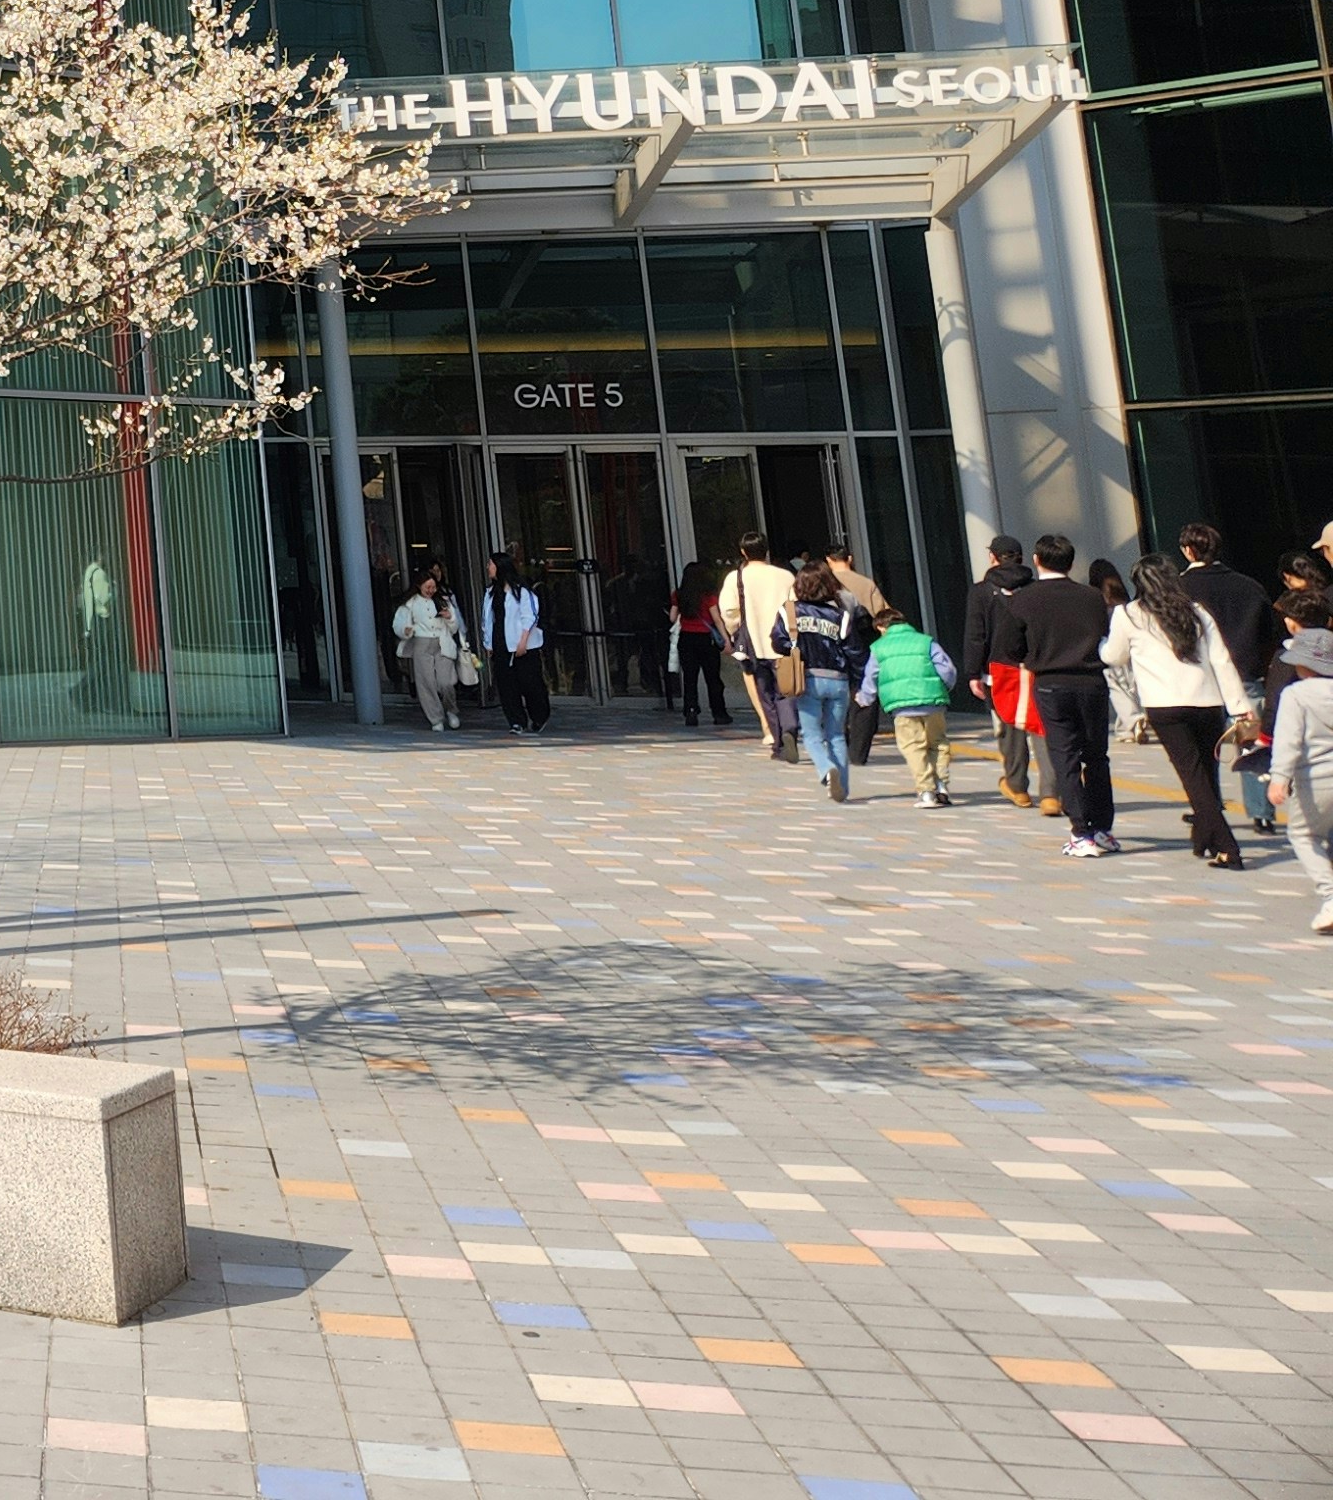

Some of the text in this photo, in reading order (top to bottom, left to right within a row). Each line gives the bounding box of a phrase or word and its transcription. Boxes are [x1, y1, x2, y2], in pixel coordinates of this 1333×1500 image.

[330, 59, 1089, 137] THE HYUNDAI SEOUL
[514, 383, 624, 408] GATE 5
